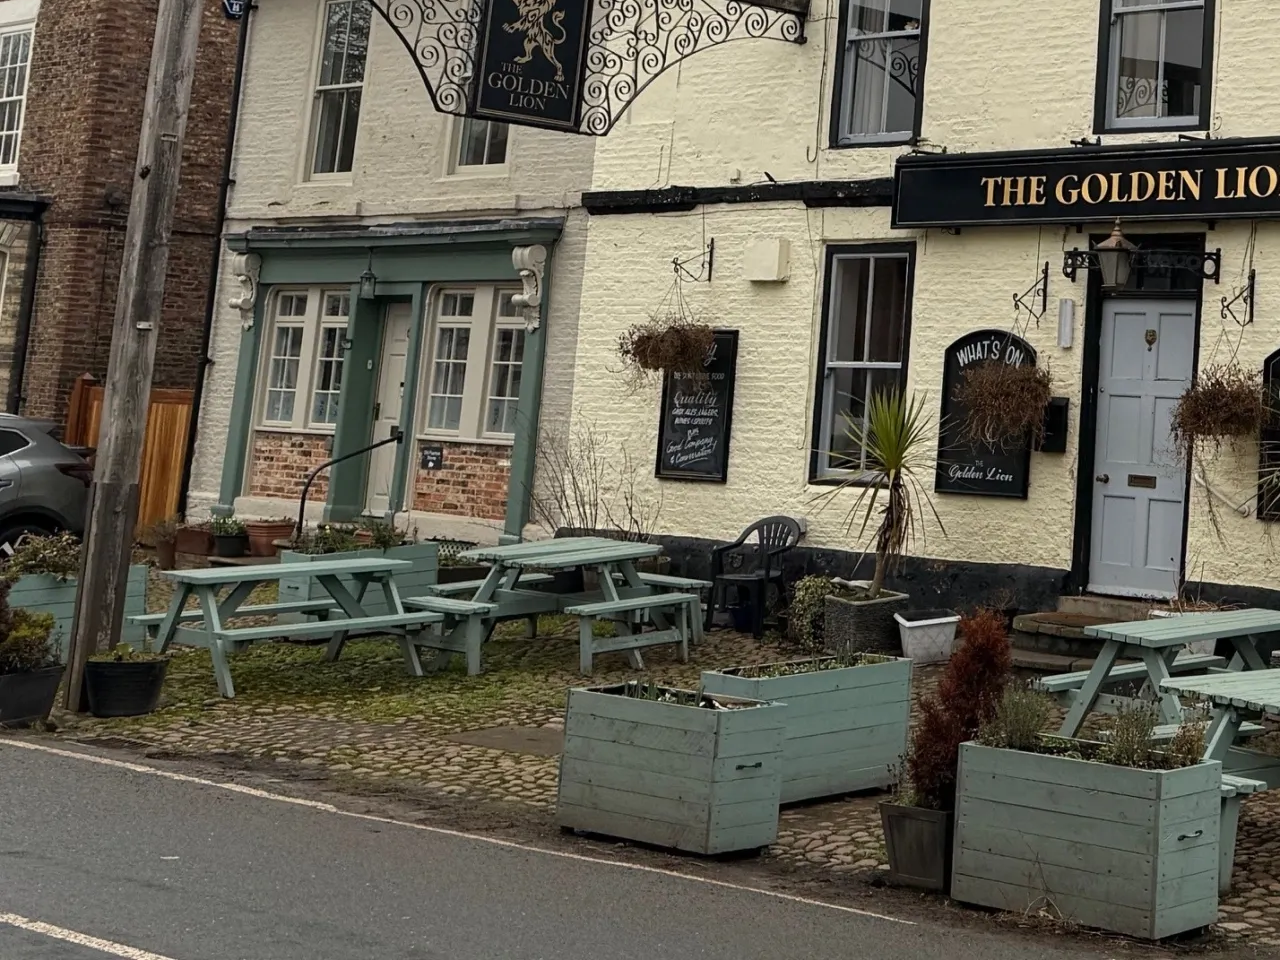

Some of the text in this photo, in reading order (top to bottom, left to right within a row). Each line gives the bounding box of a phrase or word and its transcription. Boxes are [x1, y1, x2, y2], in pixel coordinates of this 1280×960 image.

[501, 62, 523, 75] THE
[488, 71, 570, 100] GOLDEN
[509, 93, 546, 110] LION
[981, 175, 1046, 207] THE
[1055, 169, 1203, 205] GOLDEN
[956, 336, 1024, 369] WHAT'S ON
[674, 390, 719, 407] Quality
[949, 464, 1013, 482] Golden Lion
